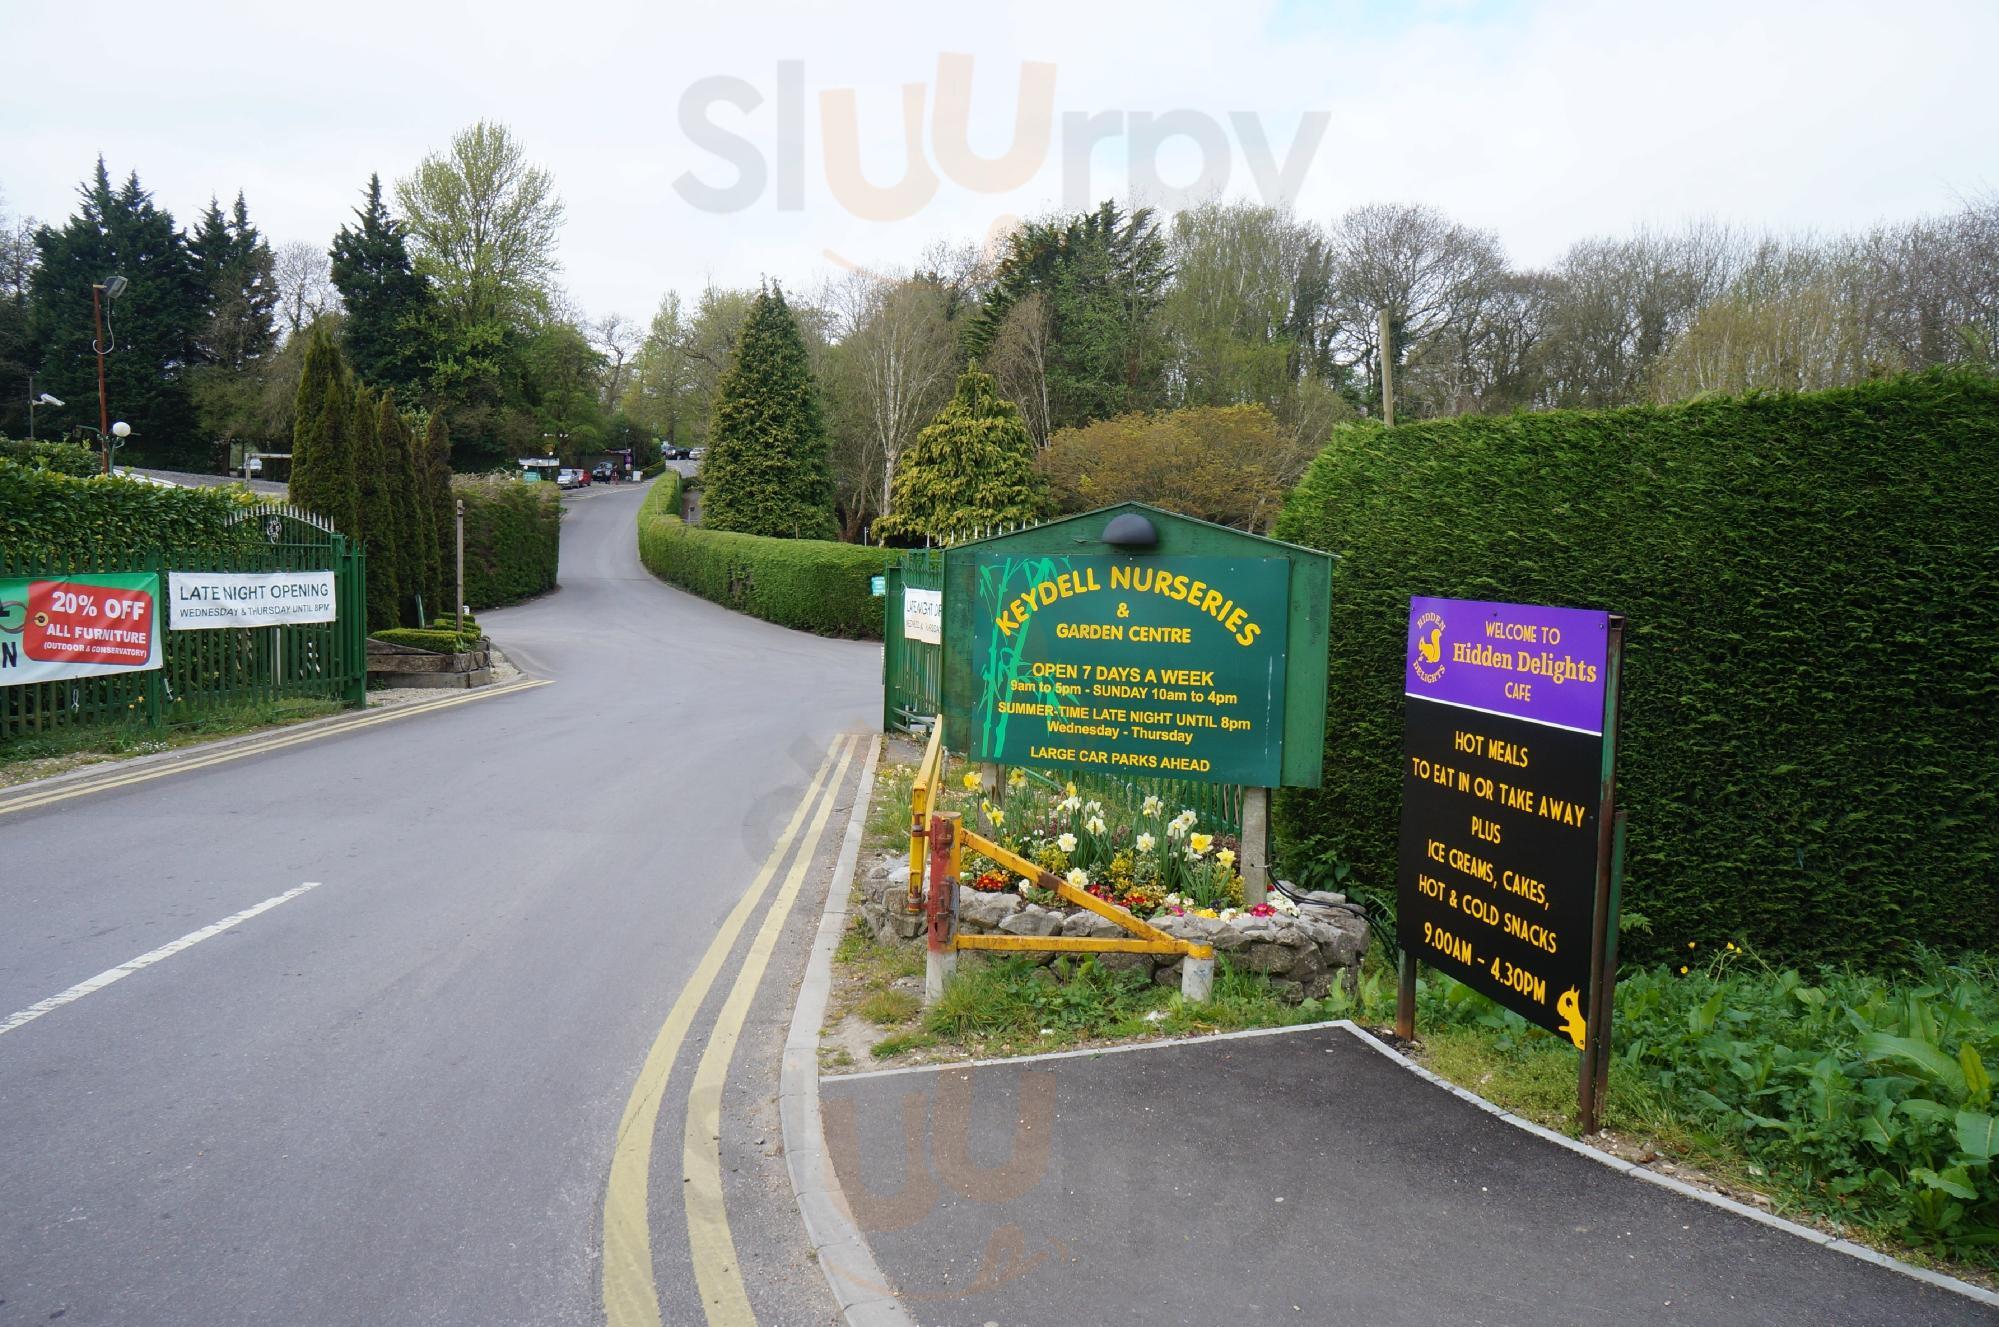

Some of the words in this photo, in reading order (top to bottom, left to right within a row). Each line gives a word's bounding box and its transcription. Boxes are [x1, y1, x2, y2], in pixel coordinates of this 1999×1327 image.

[180, 586, 220, 600] LATE
[223, 585, 266, 601] NIGHT
[270, 583, 328, 599] OPENING
[52, 591, 98, 617] 20%
[105, 598, 145, 620] OFF
[180, 607, 238, 617] WEDNESDAY
[248, 605, 290, 616] THURSDAY
[292, 604, 313, 614] UNTIL
[995, 567, 1101, 636] KEYDELL
[1110, 566, 1261, 646] NURSERIES
[1117, 602, 1129, 618] &
[47, 623, 71, 638] ALL
[75, 626, 147, 644] FURNITURE
[1056, 623, 1123, 641] GARDEN
[1128, 626, 1192, 644] CENTRE
[1417, 612, 1446, 631] HIDDEN
[1485, 620, 1537, 643] WELCOME
[1541, 626, 1561, 645] TO
[44, 642, 85, 652] (OUTDOOR
[91, 645, 147, 659] CONSERVATORY)
[1032, 662, 1078, 679] OPEN
[1082, 665, 1092, 680] 7
[1096, 666, 1141, 683] DAYS
[1144, 669, 1157, 684] A
[1161, 669, 1214, 687] WEEK
[1413, 659, 1445, 683] DELIGHTS
[1453, 642, 1513, 670] Hidden
[1517, 651, 1597, 685] Delights
[1010, 679, 1036, 692] 9am
[1038, 681, 1052, 693] to
[1055, 682, 1082, 697] 5pm
[1093, 684, 1149, 700] SUNDAY
[1151, 687, 1187, 702] 10am
[1190, 690, 1204, 703] to
[1207, 691, 1238, 704] 4pm
[1504, 681, 1532, 702] CAFE
[1093, 708, 1127, 722] LATE
[1130, 711, 1173, 726] NIGHT
[1176, 713, 1217, 728] UNTIL
[1221, 716, 1251, 730] 8pm
[1047, 720, 1120, 740] Wednesday
[1131, 726, 1193, 745] Thursday
[1030, 746, 1077, 762] LARGE
[1079, 750, 1109, 764] CAR
[1112, 752, 1157, 768] PARKS
[1160, 756, 1211, 772] AHEAD
[1455, 730, 1484, 756] HOT
[1488, 738, 1529, 768] MEALS
[1412, 757, 1431, 779] TO
[1433, 764, 1455, 787] EAT
[1458, 771, 1470, 793] IN
[1474, 777, 1494, 801] OR
[1499, 783, 1534, 813] TAKE
[1538, 795, 1586, 828] AWAY
[1471, 816, 1501, 845] PLUS
[1427, 838, 1445, 863] ICE
[1449, 848, 1497, 889] CREAMS,
[1502, 870, 1550, 911] CAKES,
[1419, 874, 1446, 901] HOT
[1449, 889, 1458, 909] &
[1462, 894, 1499, 926] COLD
[1503, 912, 1557, 954] SNACKS
[1424, 922, 1472, 966] 9.00AM
[1490, 957, 1546, 1005] 4.30PM
